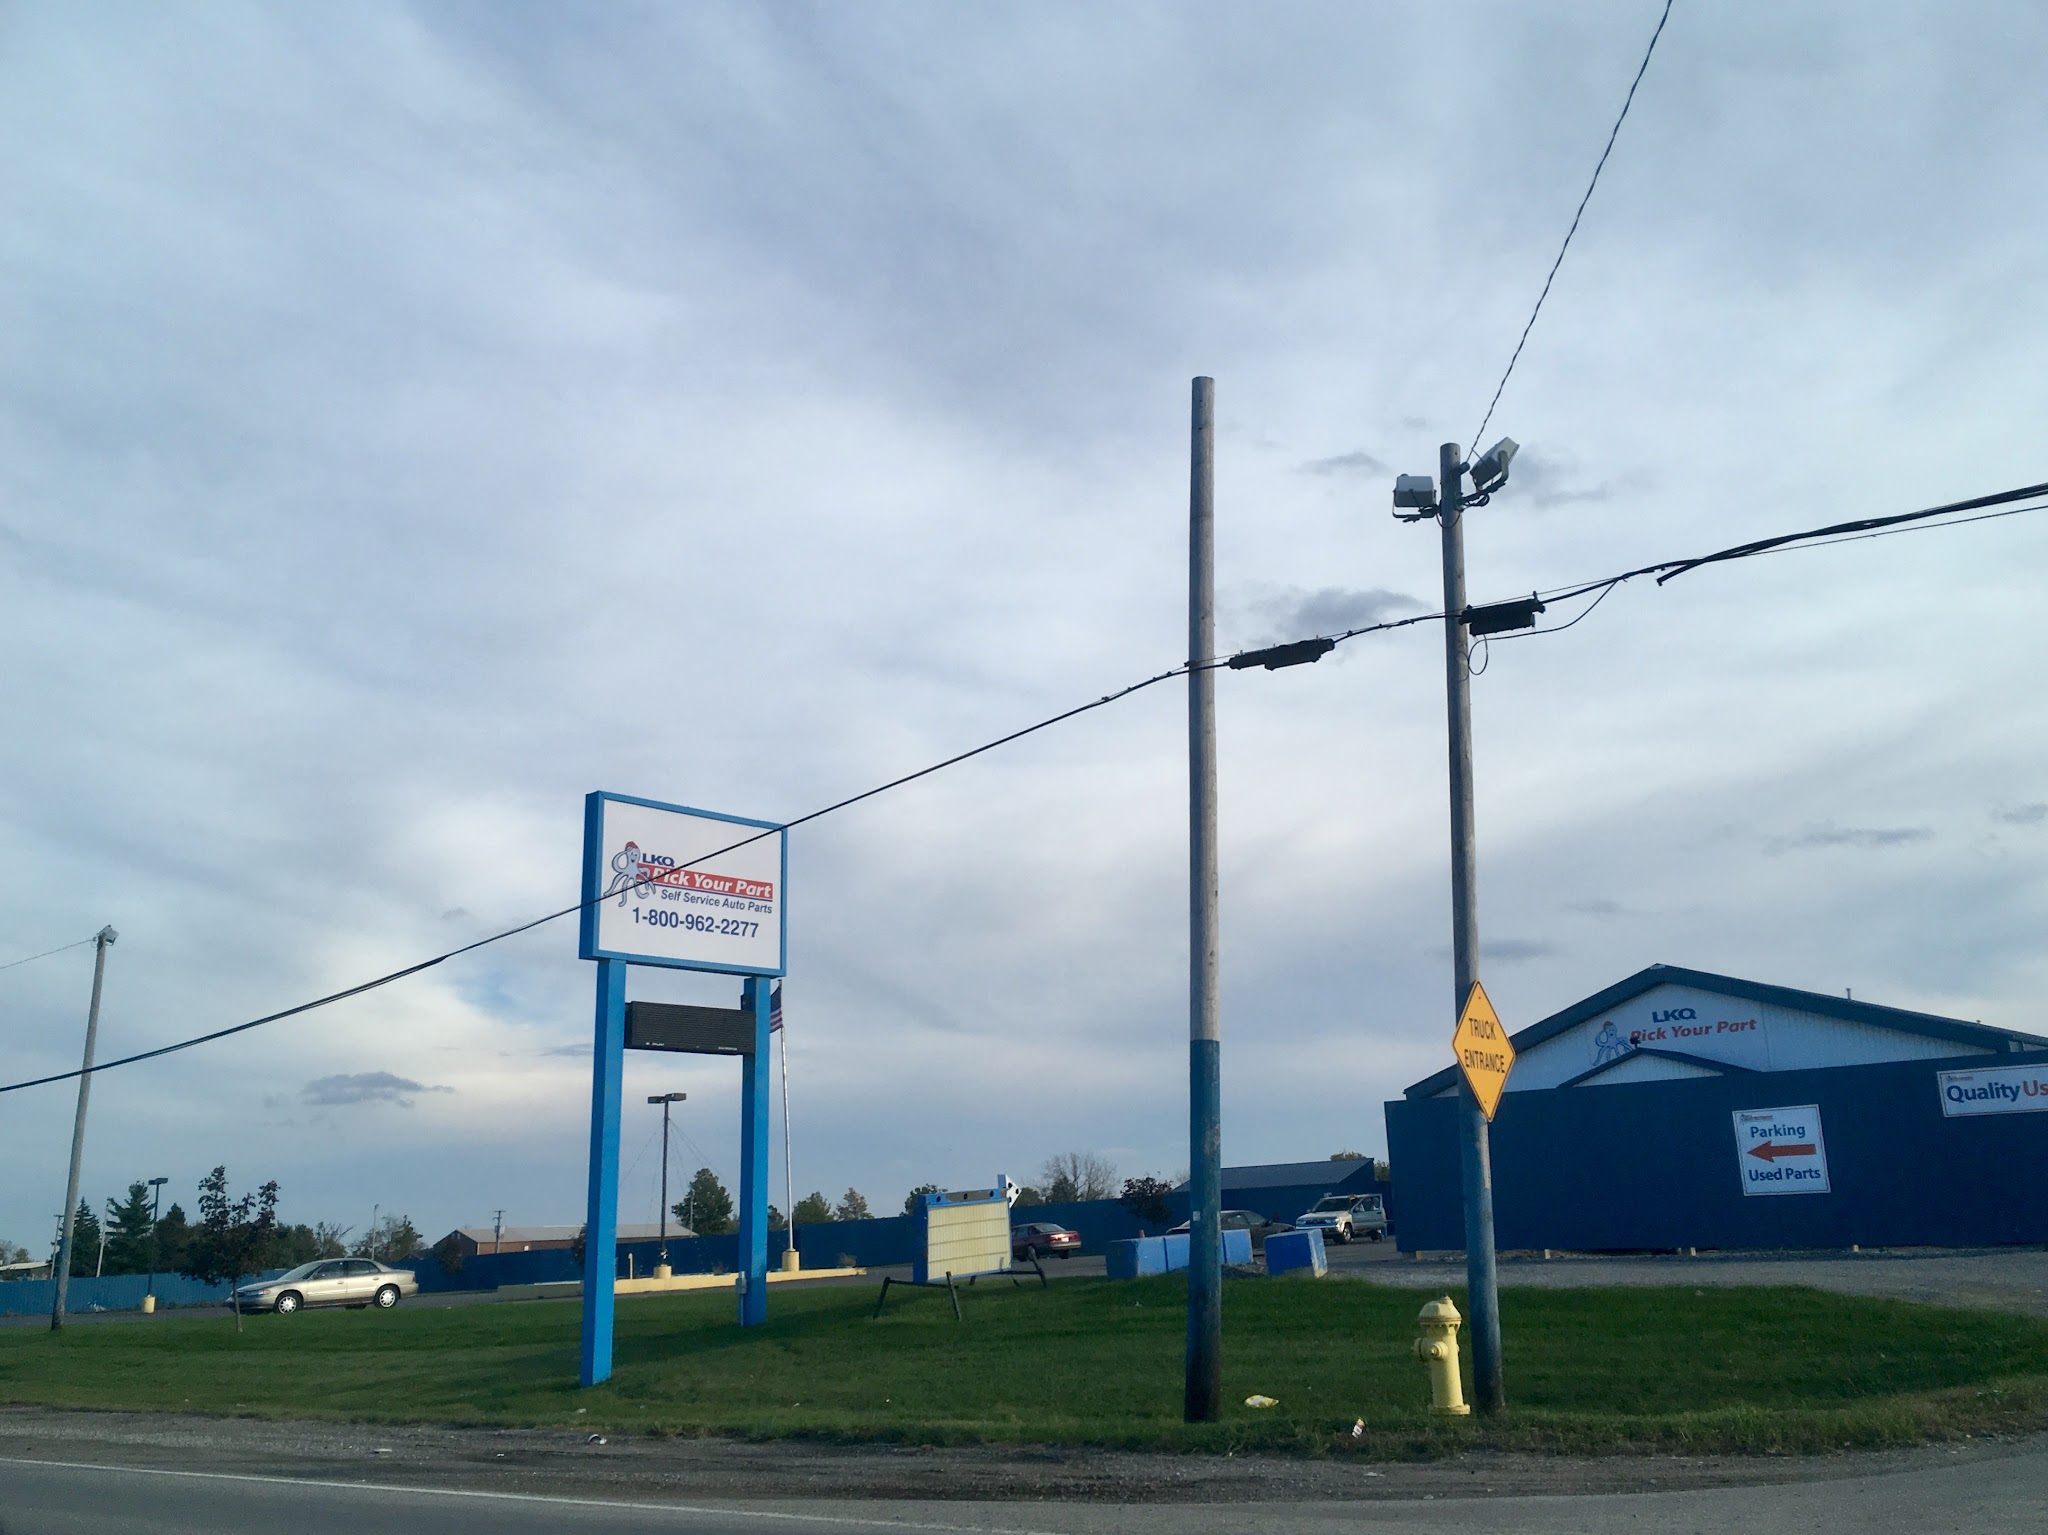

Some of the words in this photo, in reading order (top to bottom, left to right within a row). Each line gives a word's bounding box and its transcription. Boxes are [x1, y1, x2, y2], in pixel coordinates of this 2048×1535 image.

[642, 853, 675, 867] LKQ
[653, 868, 690, 886] Pick
[694, 874, 733, 892] Your
[735, 883, 772, 898] Part
[660, 889, 681, 901] Self
[683, 893, 720, 907] Service
[722, 899, 746, 910] Auto
[747, 902, 773, 914] Parts
[632, 907, 759, 938] 1-800-962-2277
[1652, 1008, 1697, 1023] LKQ
[1468, 1017, 1497, 1041] TRUCK
[1631, 1028, 1667, 1042] Pick
[1671, 1024, 1713, 1038] Your
[1717, 1019, 1757, 1033] Part
[1464, 1048, 1505, 1074] ENTRANCE
[1946, 1082, 2020, 1103] Quality
[1750, 1124, 1806, 1139] Parking
[1748, 1168, 1782, 1182] Used
[1785, 1167, 1821, 1180] Parts
